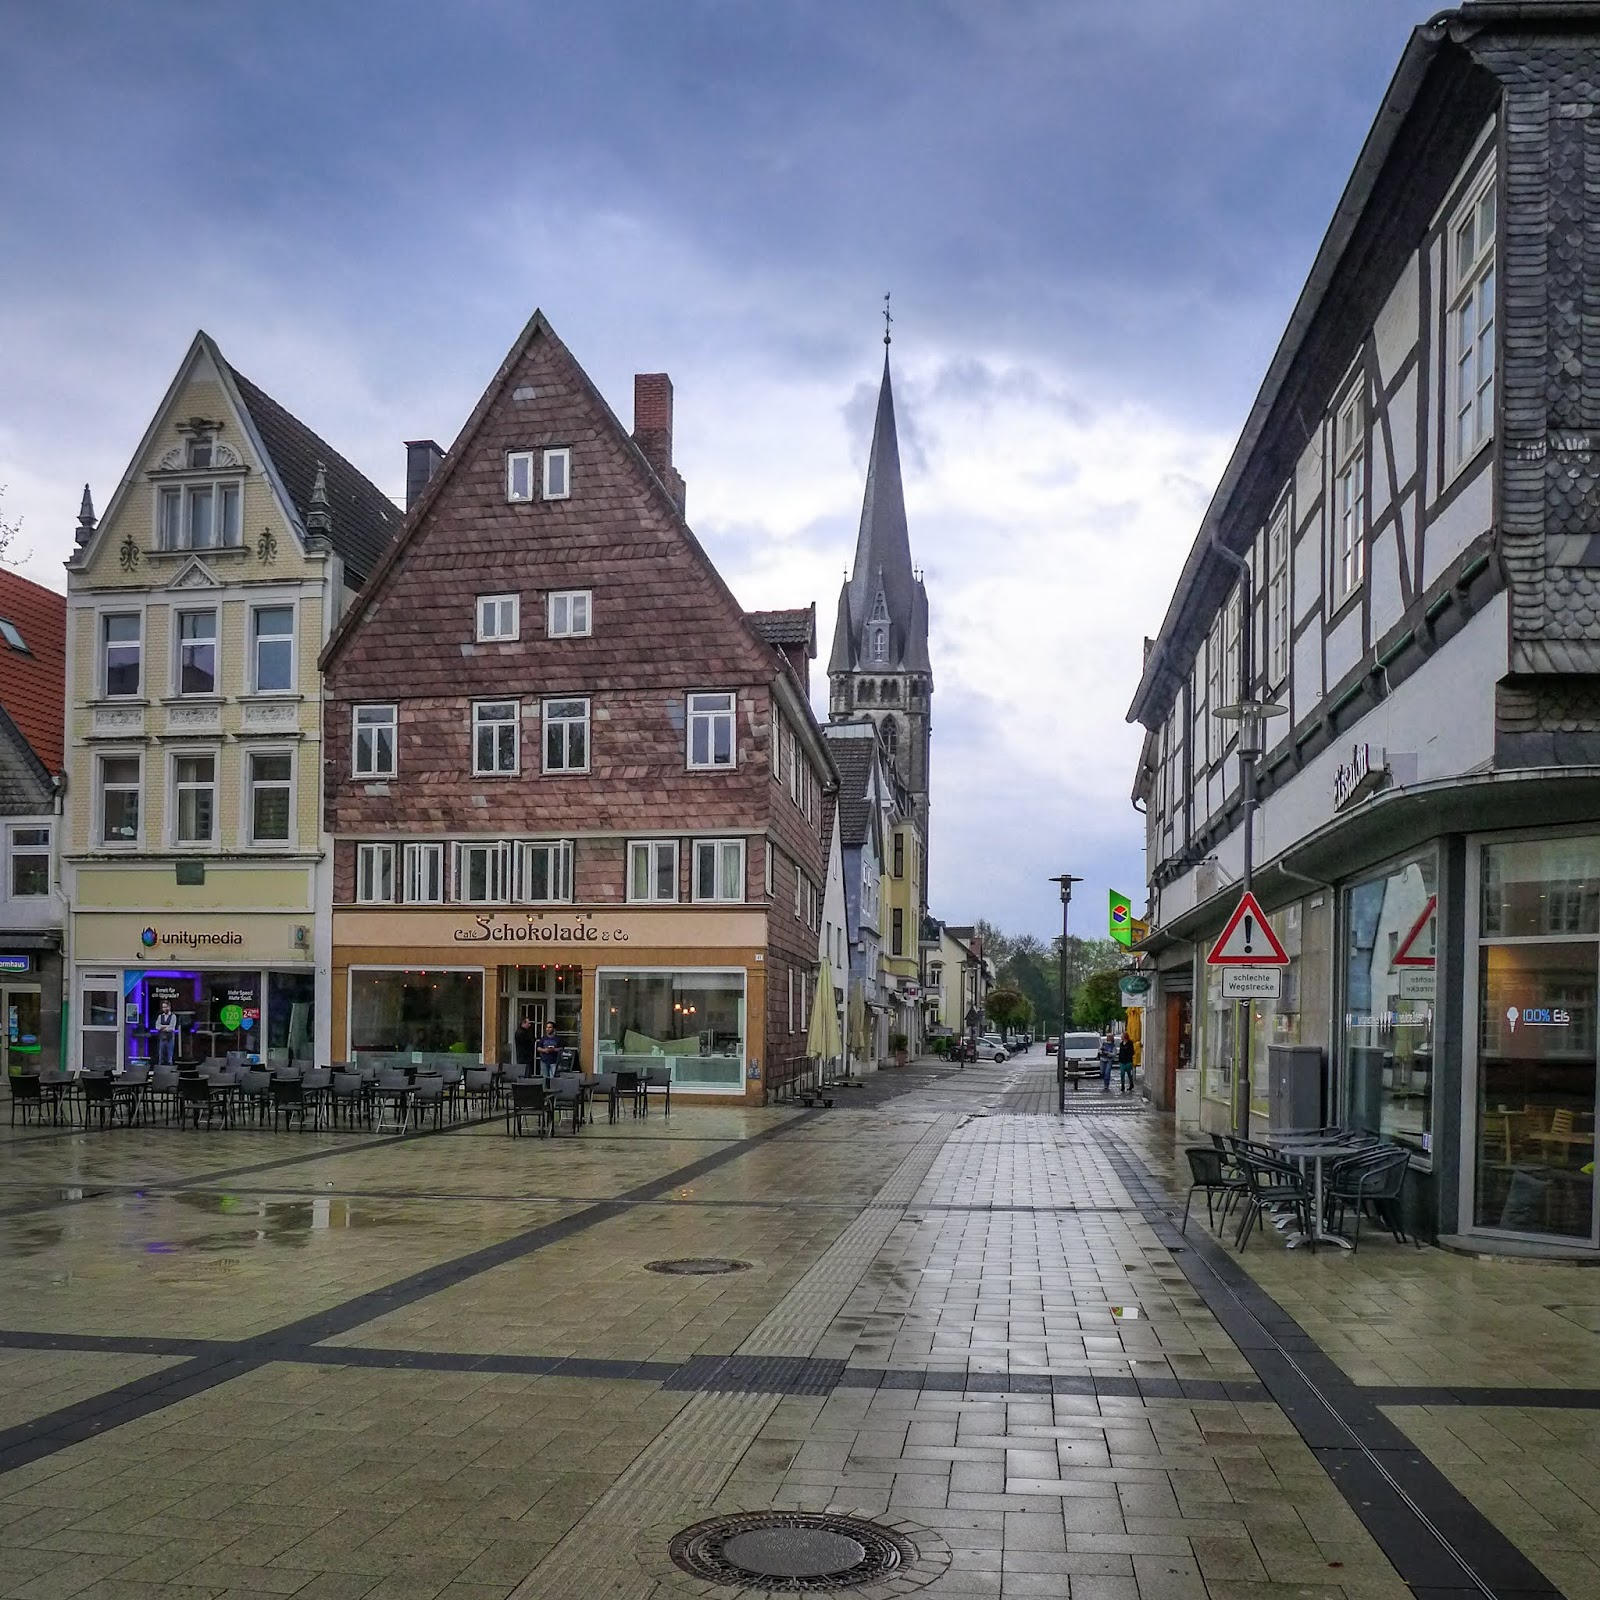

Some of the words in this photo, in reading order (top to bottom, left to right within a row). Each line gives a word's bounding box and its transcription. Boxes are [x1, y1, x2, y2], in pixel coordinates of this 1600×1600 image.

[476, 918, 598, 941] Schokolade
[601, 932, 610, 940] &
[613, 929, 629, 941] Co
[162, 931, 243, 949] unitymedia
[1229, 983, 1275, 991] Wegstrecke
[1523, 1009, 1551, 1022] 100%
[1553, 1009, 1570, 1022] Eis
